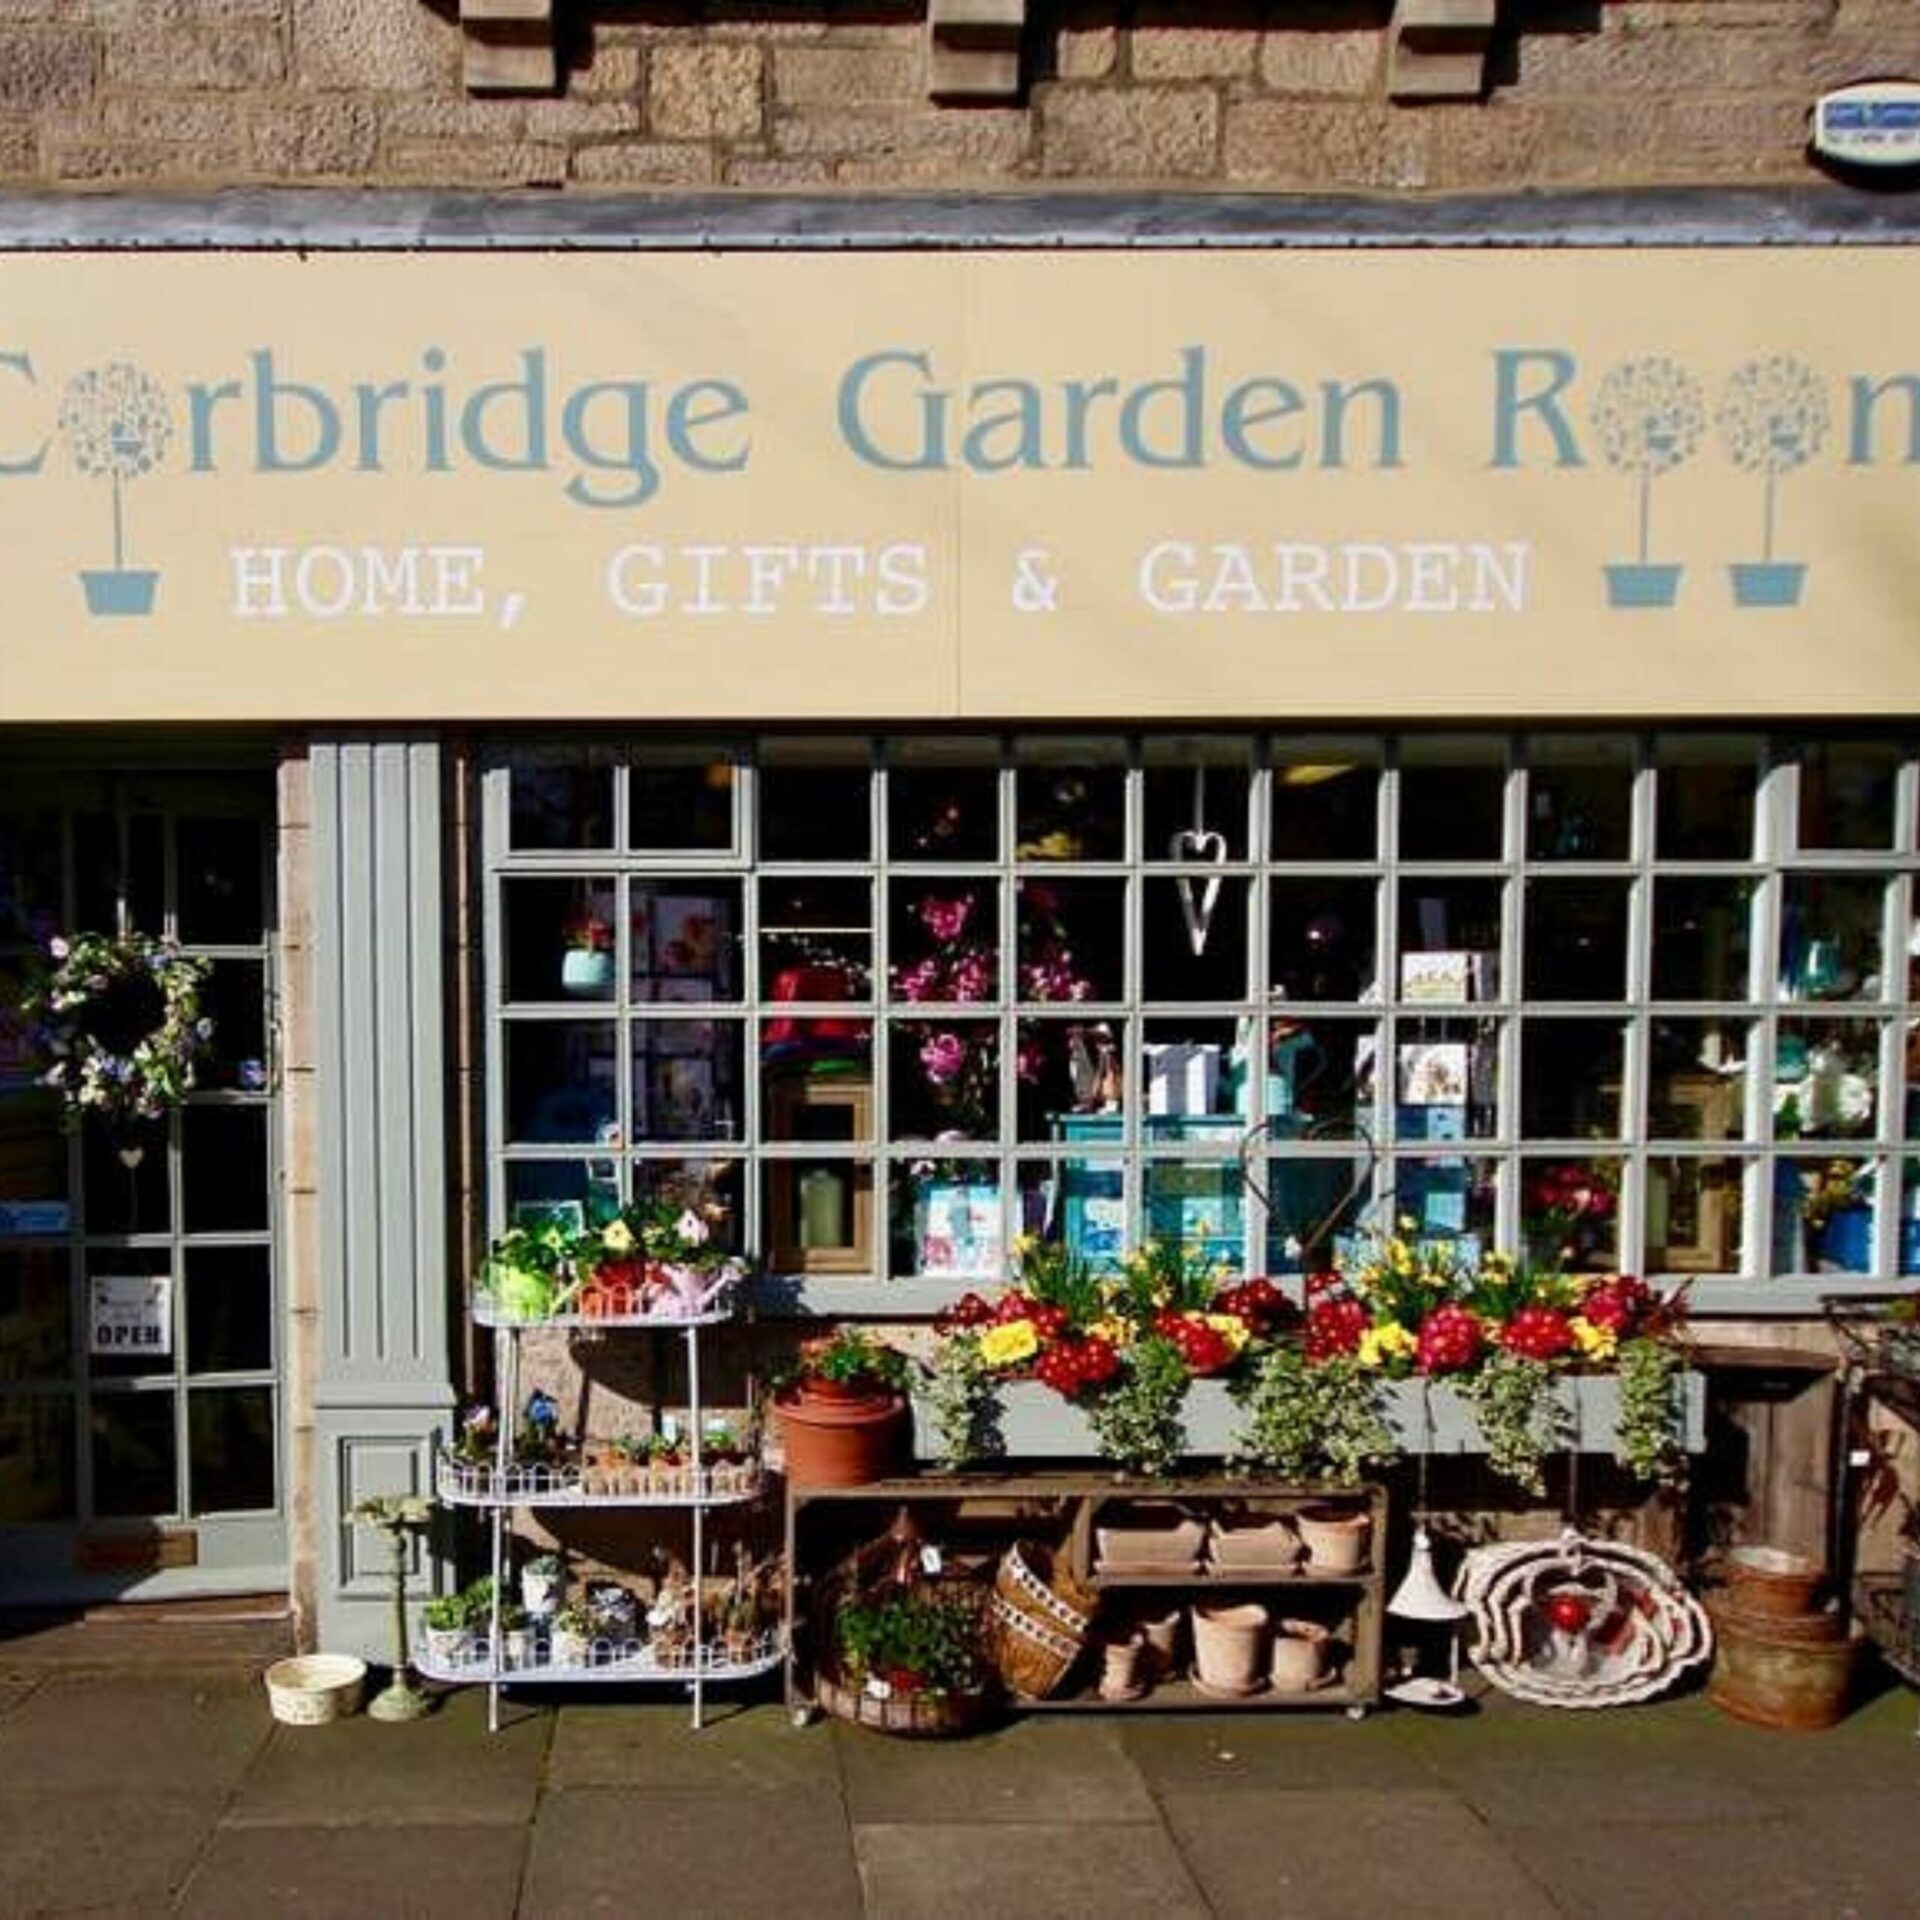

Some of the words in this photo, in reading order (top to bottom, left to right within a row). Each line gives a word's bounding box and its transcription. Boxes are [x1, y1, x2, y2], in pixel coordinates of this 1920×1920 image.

[837, 345, 1406, 473] Garden
[229, 545, 527, 630] HOME,
[606, 543, 932, 616] GIFTS
[1010, 547, 1059, 613] &
[1138, 541, 1531, 613] GARDEN
[97, 1325, 162, 1345] OPEN
